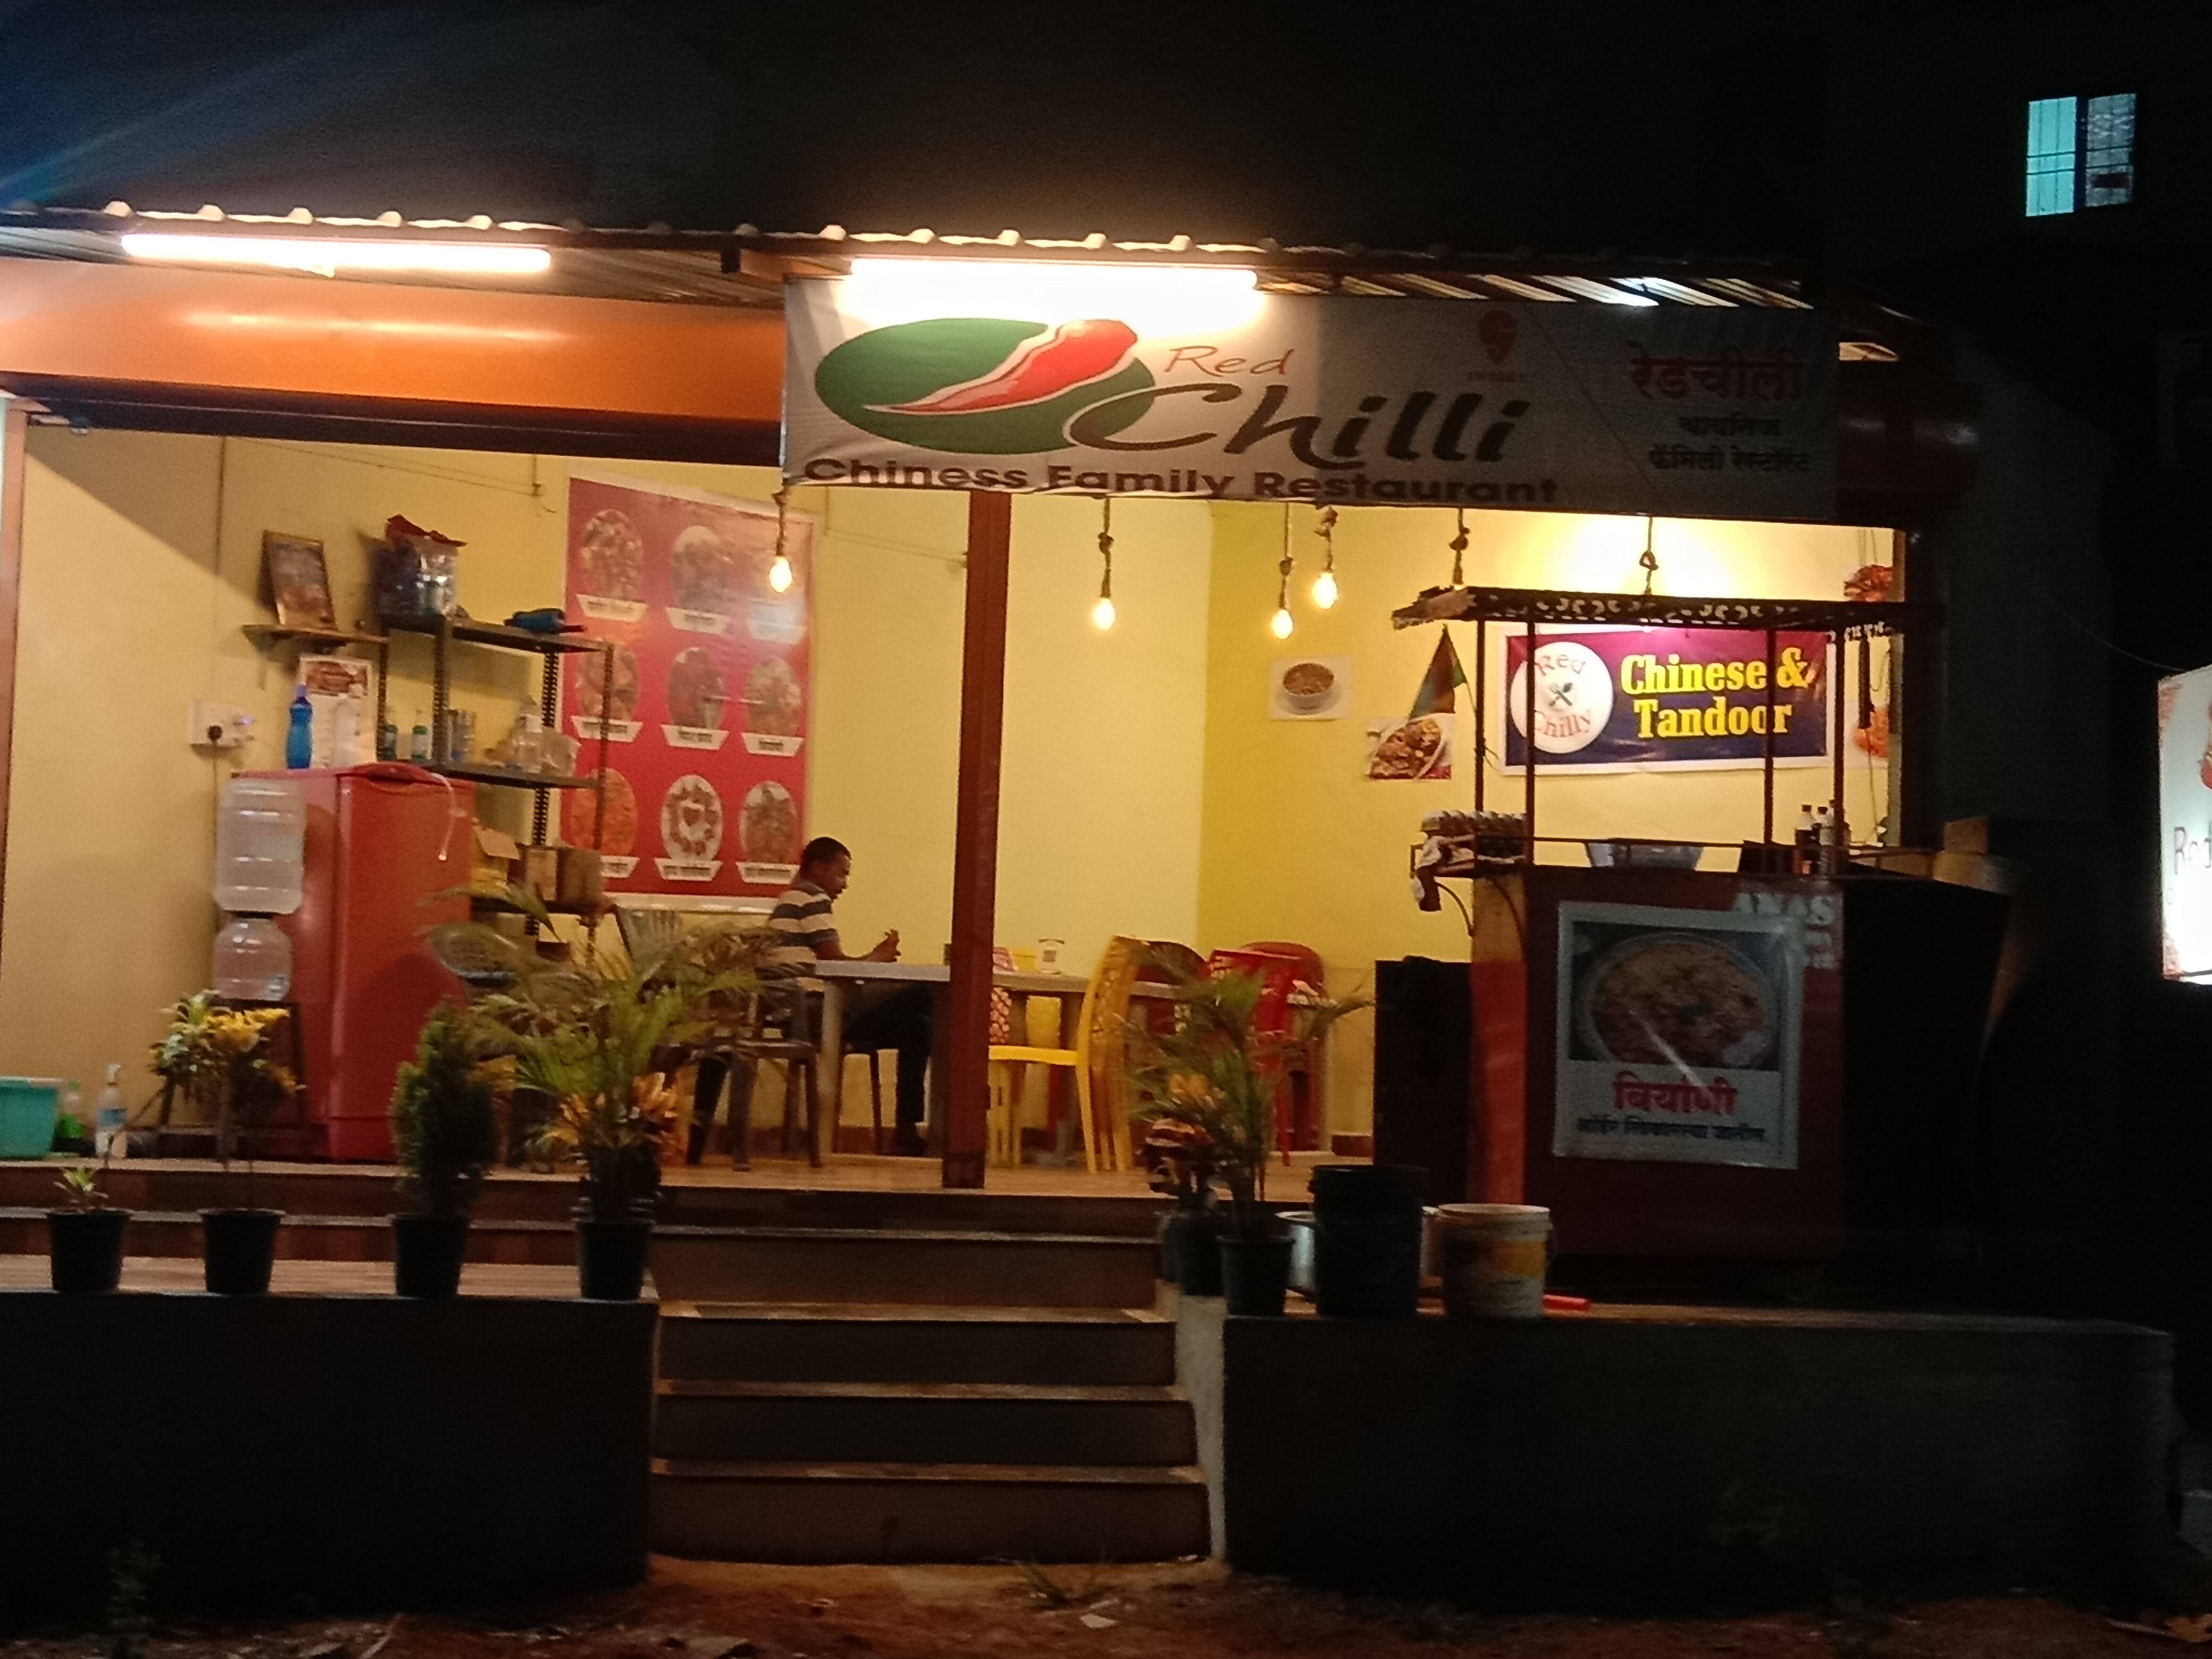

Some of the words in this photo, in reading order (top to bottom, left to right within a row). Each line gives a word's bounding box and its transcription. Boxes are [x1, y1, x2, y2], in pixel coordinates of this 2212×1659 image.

[1164, 345, 1294, 377] Red
[1069, 382, 1531, 470] Chilli
[805, 458, 1028, 487] Chiness
[1048, 465, 1235, 497] Family
[1254, 471, 1560, 502] Restaurant
[1621, 653, 1767, 694] Chinese
[1777, 647, 1812, 688] &
[1633, 696, 1792, 738] Tandoor
